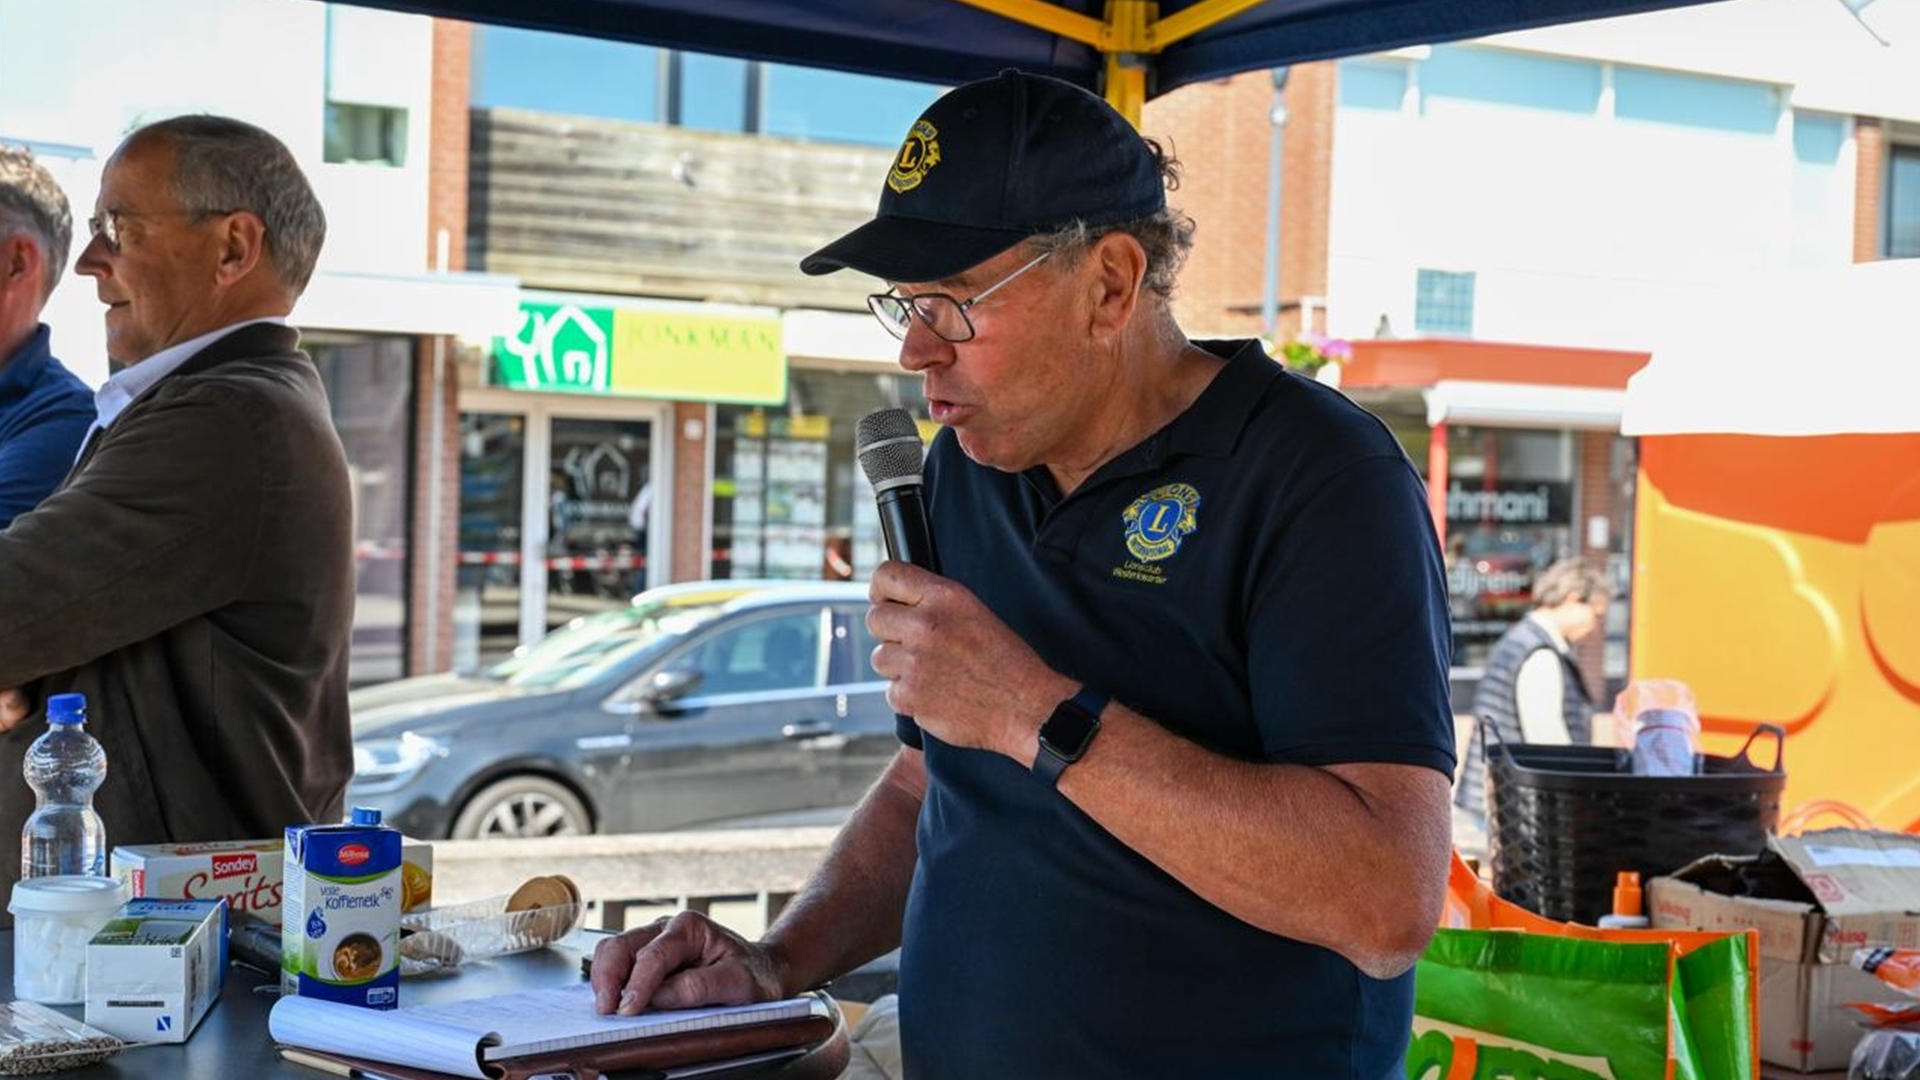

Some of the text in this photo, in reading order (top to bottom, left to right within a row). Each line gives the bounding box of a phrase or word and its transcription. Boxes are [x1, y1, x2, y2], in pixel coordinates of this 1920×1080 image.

[899, 141, 916, 168] L
[1447, 481, 1549, 521] hmani
[1147, 505, 1169, 532] L
[214, 857, 258, 876] Sondey
[183, 872, 284, 913] Srits
